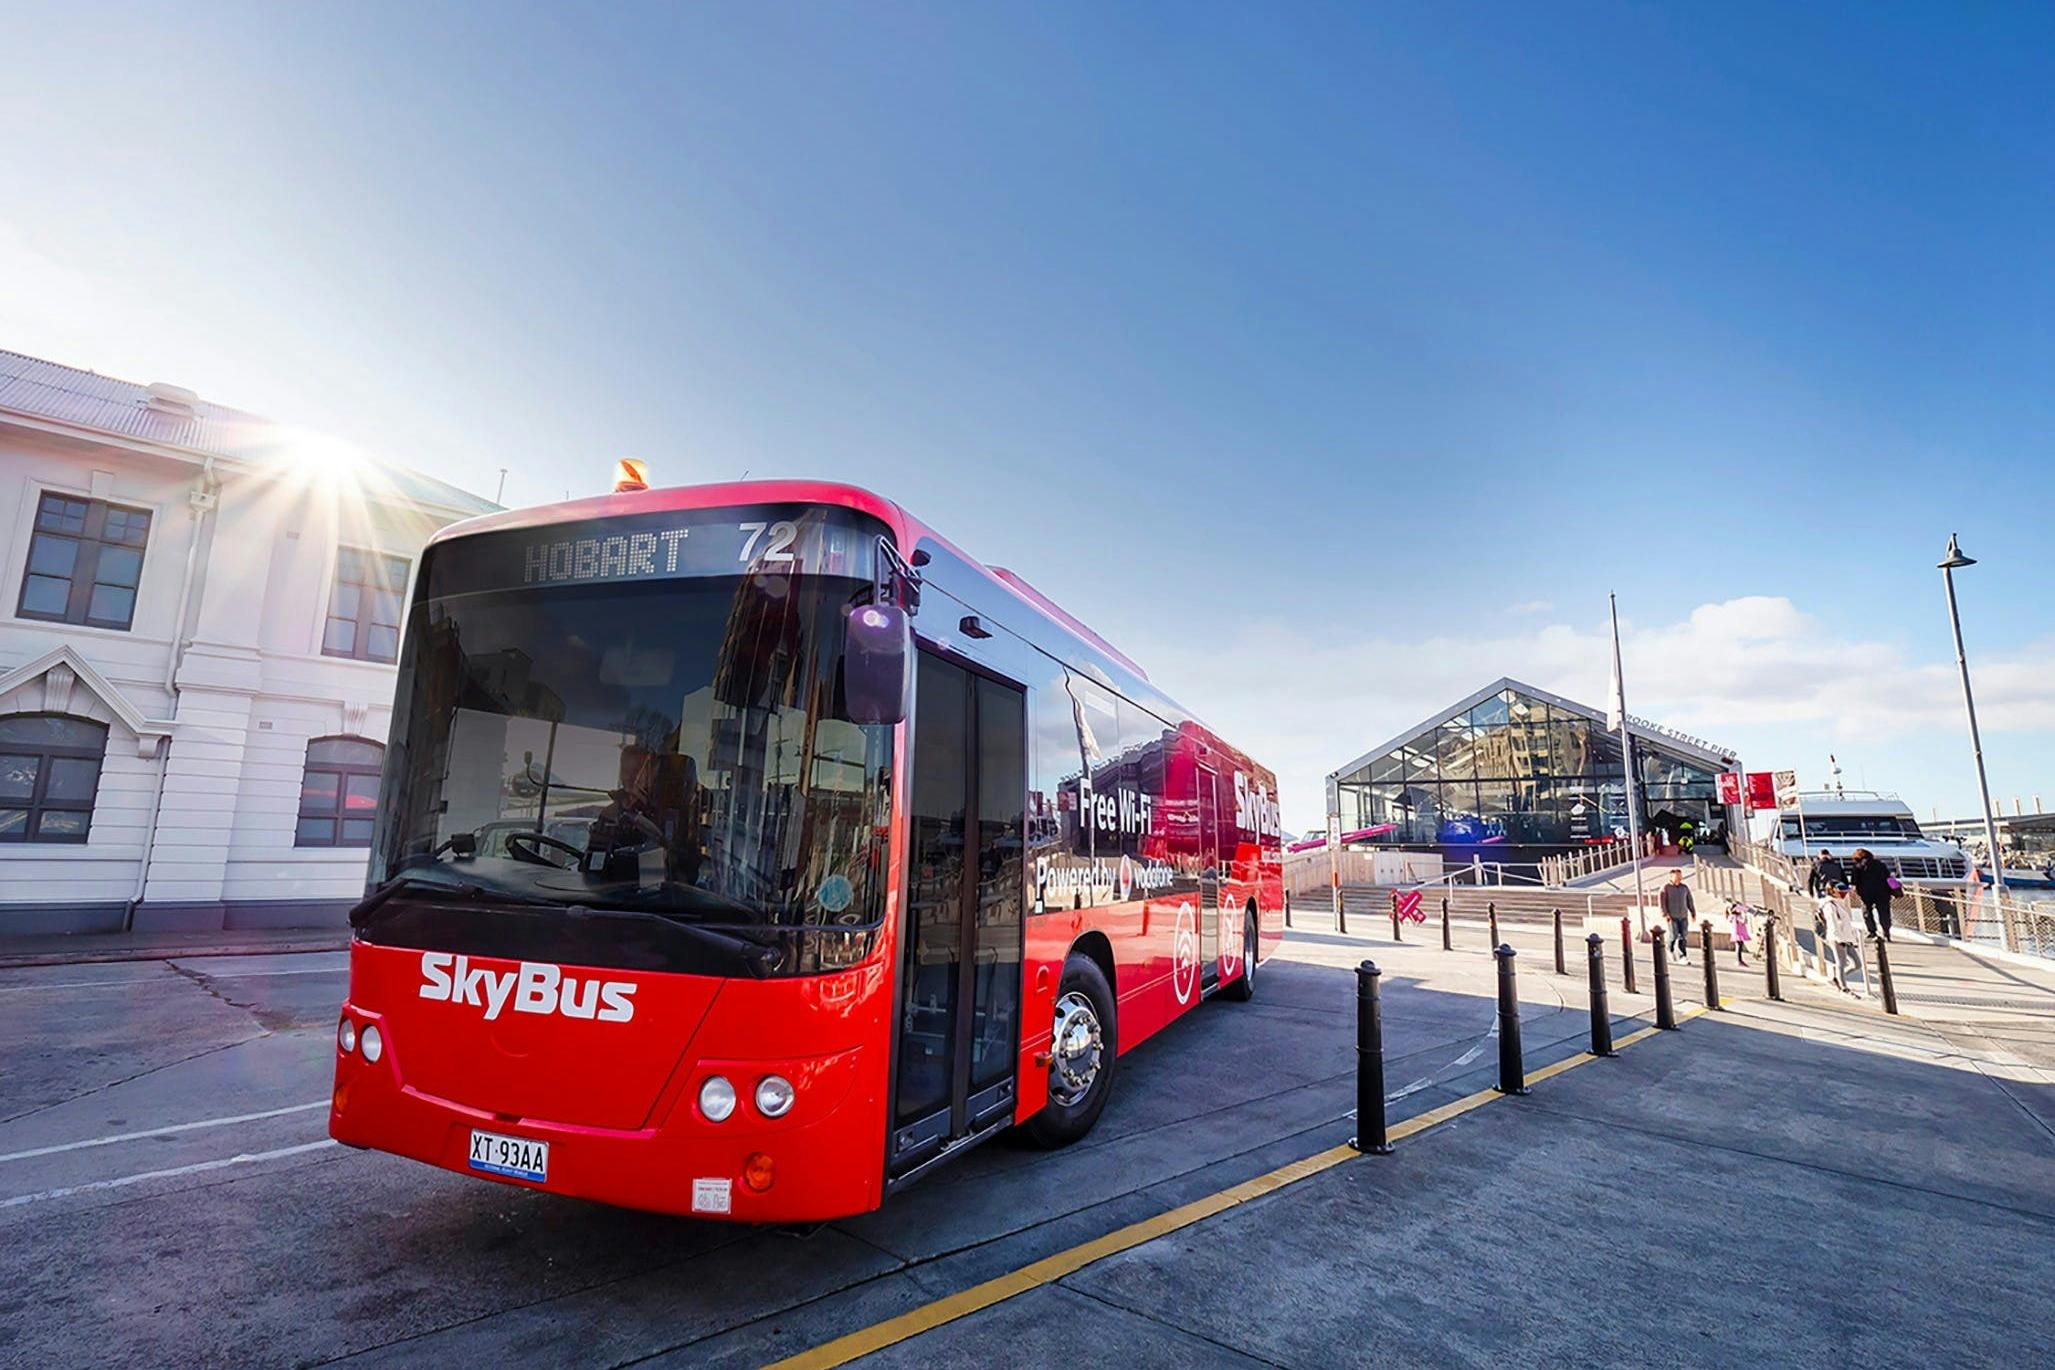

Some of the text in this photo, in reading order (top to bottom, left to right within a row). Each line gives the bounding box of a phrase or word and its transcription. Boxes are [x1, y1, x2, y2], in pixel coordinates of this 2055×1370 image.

[524, 529, 689, 583] HOBART
[738, 521, 798, 562] 72
[1625, 713, 1738, 759] ROOKE STREET PIER
[1079, 777, 1152, 836] Free Wi-Fi
[1233, 769, 1281, 846] SkyBus
[1035, 856, 1173, 900] Powered by vodafone
[418, 950, 638, 1024] SkyBus
